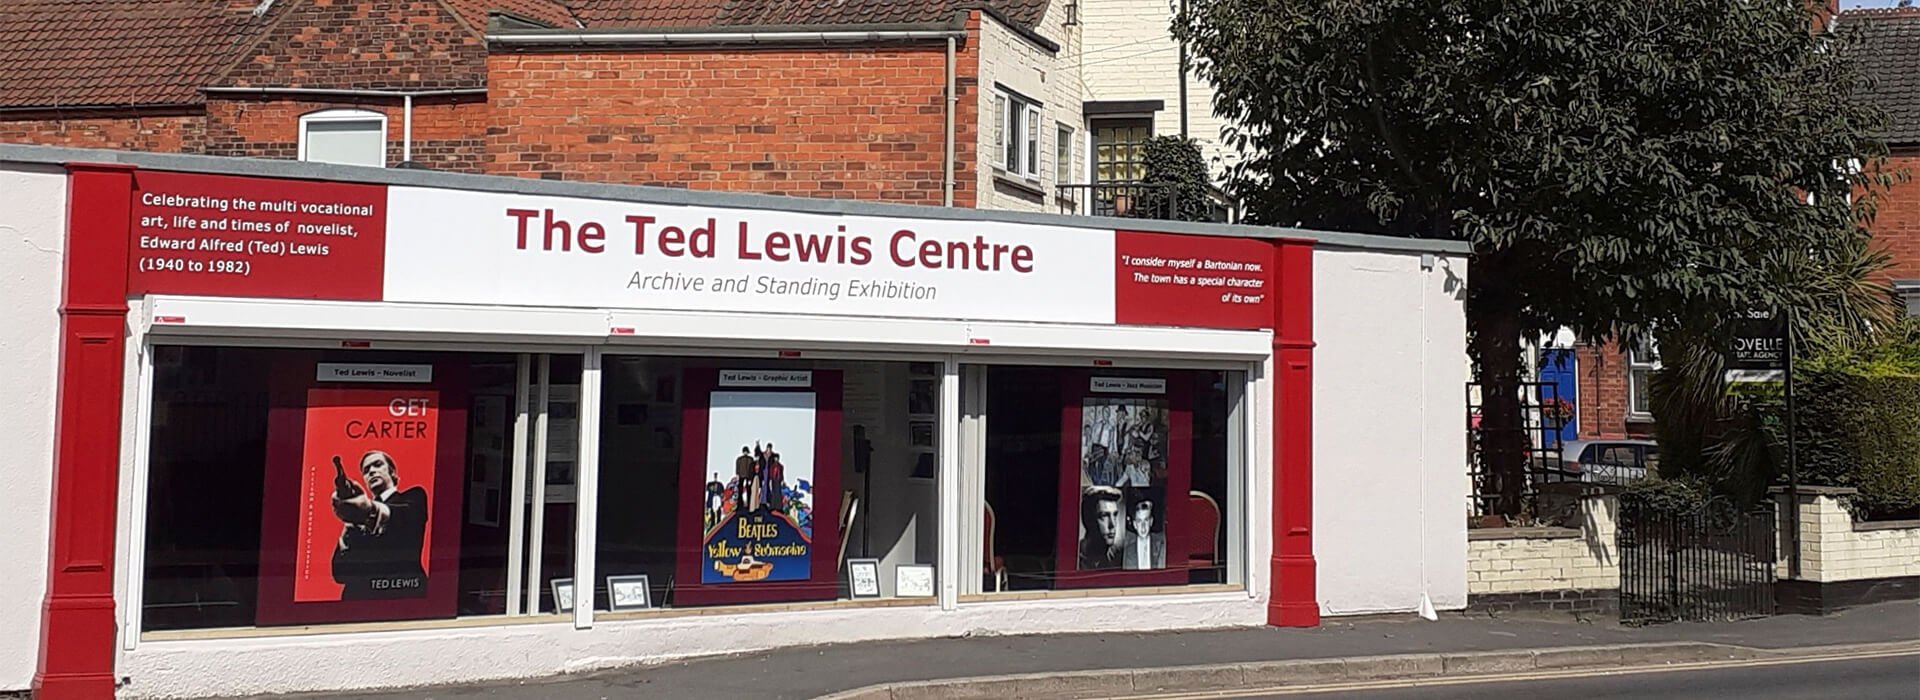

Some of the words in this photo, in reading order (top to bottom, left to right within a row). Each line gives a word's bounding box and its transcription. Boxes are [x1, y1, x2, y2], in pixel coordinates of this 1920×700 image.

[142, 193, 228, 211] Celebrating
[232, 198, 256, 211] the
[260, 200, 297, 213] multi
[301, 203, 373, 216] vocational
[141, 215, 168, 228] art,
[173, 216, 197, 229] life
[200, 217, 227, 230] and
[231, 219, 271, 232] times
[275, 221, 290, 233] of
[297, 222, 358, 237] novelist,
[140, 236, 195, 250] Edward
[200, 238, 243, 252] Alfred
[248, 240, 286, 256] (Ted)
[290, 242, 329, 255] Lewis
[506, 208, 606, 253] The
[625, 215, 716, 258] Ted
[738, 221, 873, 266] Lewis
[889, 230, 1034, 273] Centre
[139, 258, 184, 272] (1940
[188, 259, 203, 272] to
[208, 260, 250, 275] 1982)
[1131, 256, 1166, 267] consider
[1168, 258, 1195, 269] myself
[1196, 261, 1203, 269] a
[1204, 260, 1243, 271] Bartonian
[1244, 263, 1263, 272] now.
[627, 271, 705, 293] Archive
[711, 274, 749, 294] and
[756, 275, 841, 300] Standing
[848, 279, 938, 301] Exhibition
[1134, 272, 1149, 282] The
[1151, 274, 1172, 284] town
[1173, 274, 1189, 285] has
[1190, 277, 1196, 285] a
[1197, 276, 1226, 287] special
[1227, 277, 1264, 288] character
[1221, 292, 1231, 302] of
[1232, 293, 1242, 303] its
[1244, 294, 1264, 304] own"
[334, 368, 350, 377] Ted
[352, 369, 376, 377] Lewis
[383, 369, 417, 378] Novelist
[723, 373, 737, 381] Ted
[763, 374, 788, 383] Graphic
[389, 398, 429, 417] GET
[346, 420, 428, 439] CARTER
[708, 540, 742, 558] Yellow
[371, 579, 390, 589] TED
[391, 578, 420, 589] LEWIS
